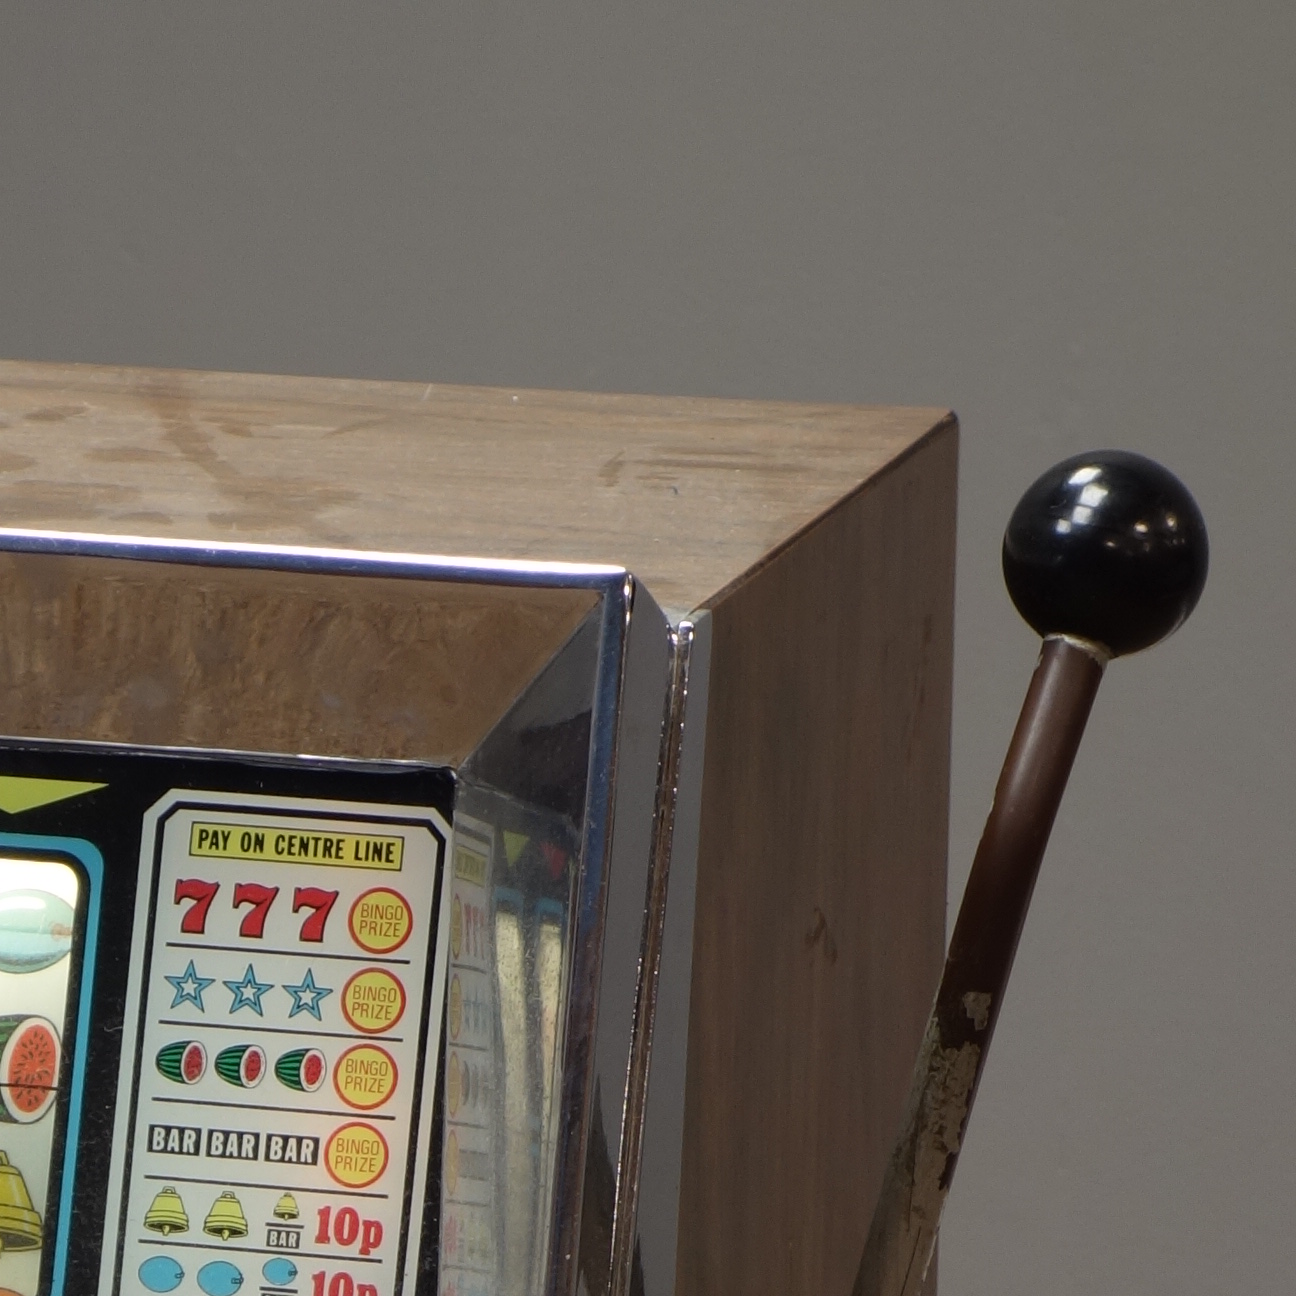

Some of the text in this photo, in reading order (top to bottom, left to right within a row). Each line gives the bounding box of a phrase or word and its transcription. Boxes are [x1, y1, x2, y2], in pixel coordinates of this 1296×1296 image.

[197, 828, 396, 864] PAY ON CENTRE LINE
[173, 878, 340, 943] 7 7 7
[360, 902, 404, 922] BINGO
[358, 920, 401, 938] PRIZE
[352, 984, 397, 1004] BINGO
[351, 1002, 393, 1021] PRIZE
[345, 1058, 389, 1077] BINGO
[344, 1075, 385, 1094] PRIZE
[151, 1126, 314, 1164] BAR BAR BAR
[336, 1137, 380, 1157] BINGO
[334, 1155, 377, 1173] PRIZE
[268, 1230, 298, 1248] BAR
[314, 1205, 384, 1256] 10p
